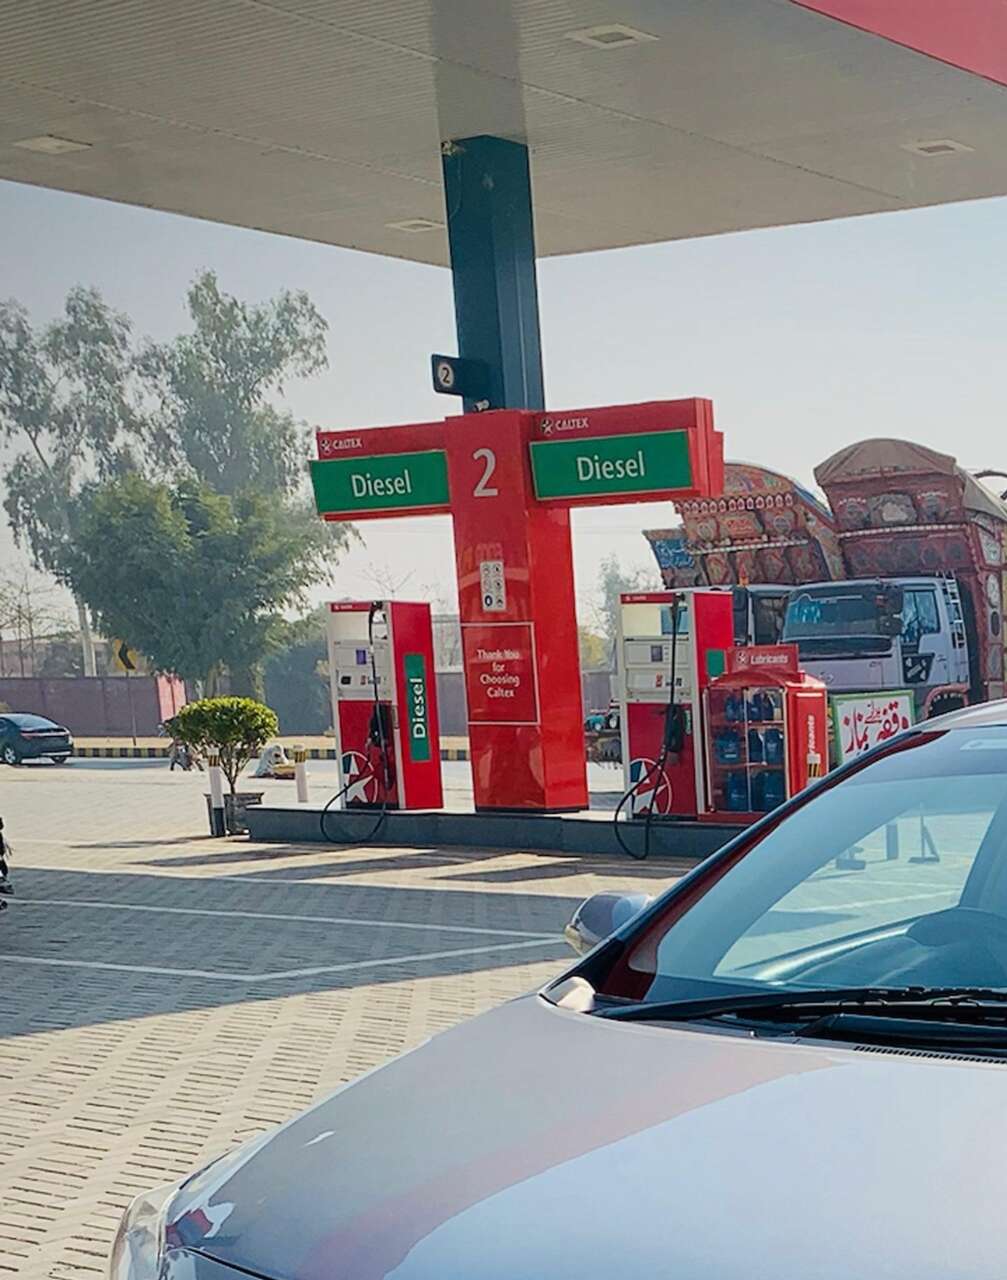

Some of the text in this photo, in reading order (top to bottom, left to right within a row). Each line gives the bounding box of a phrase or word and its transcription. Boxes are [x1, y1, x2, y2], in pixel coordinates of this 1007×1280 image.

[441, 366, 451, 384] 2
[555, 417, 590, 431] CALTEX
[332, 438, 363, 450] CALTEX
[472, 447, 499, 498] 2
[576, 450, 646, 482] Diesel
[351, 468, 412, 498] Diesel
[750, 653, 790, 665] Lubricants
[492, 661, 505, 672] for
[480, 673, 520, 687] Choosing
[487, 687, 514, 698] Caltex
[410, 677, 426, 739] Diesel
